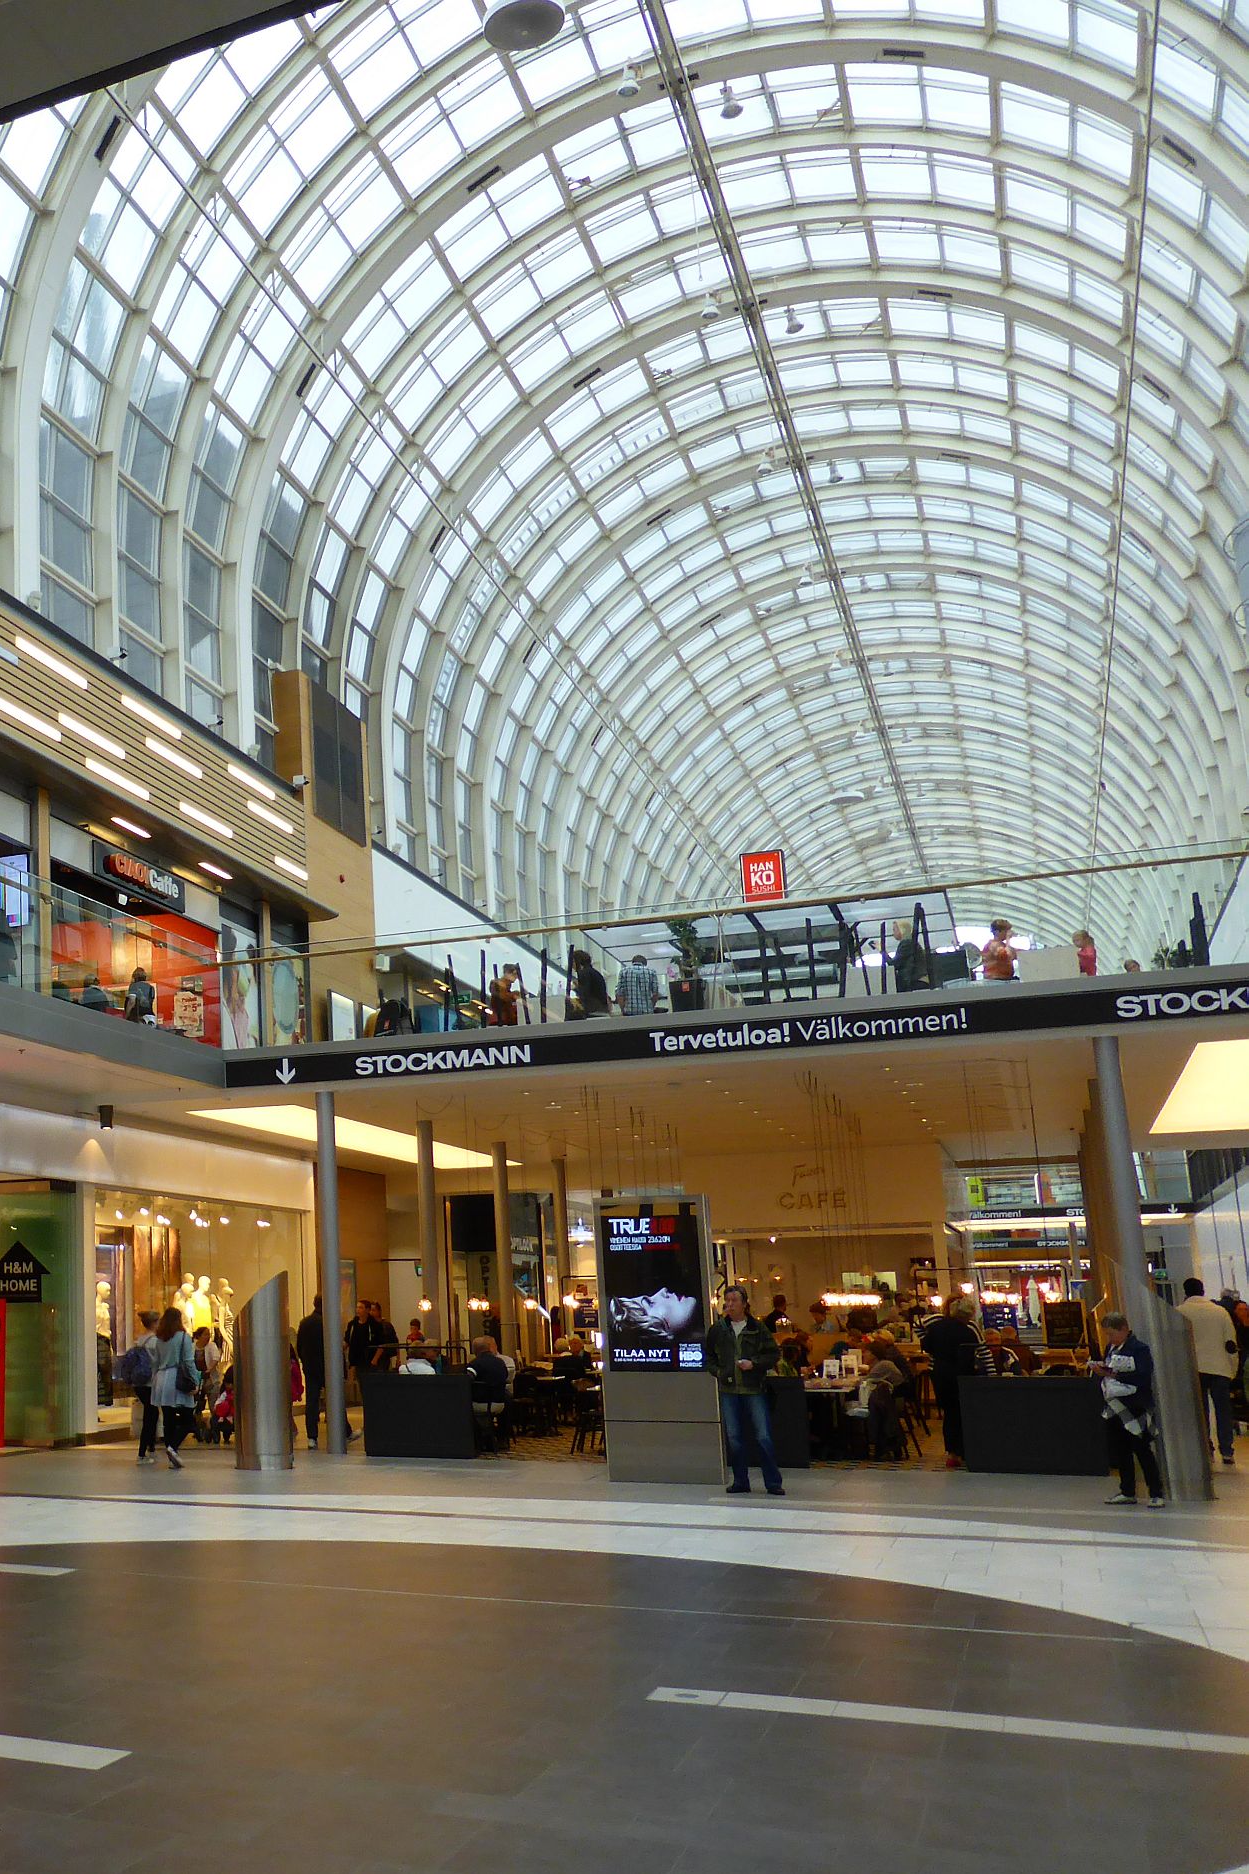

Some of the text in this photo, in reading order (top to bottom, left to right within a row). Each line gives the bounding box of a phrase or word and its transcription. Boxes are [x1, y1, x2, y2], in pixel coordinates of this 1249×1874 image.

[750, 861, 774, 872] HAN
[751, 870, 775, 887] KO
[751, 884, 776, 894] SUSHI
[1116, 986, 1249, 1018] STOCK
[649, 1007, 968, 1052] Tervetuloa! Välkommen!
[355, 1044, 531, 1076] STOCKMANN
[3, 1261, 34, 1275] H&M
[0, 1279, 38, 1293] HOME
[614, 1349, 646, 1357] TILAA
[649, 1349, 670, 1357] NYT
[679, 1351, 702, 1361] HBO
